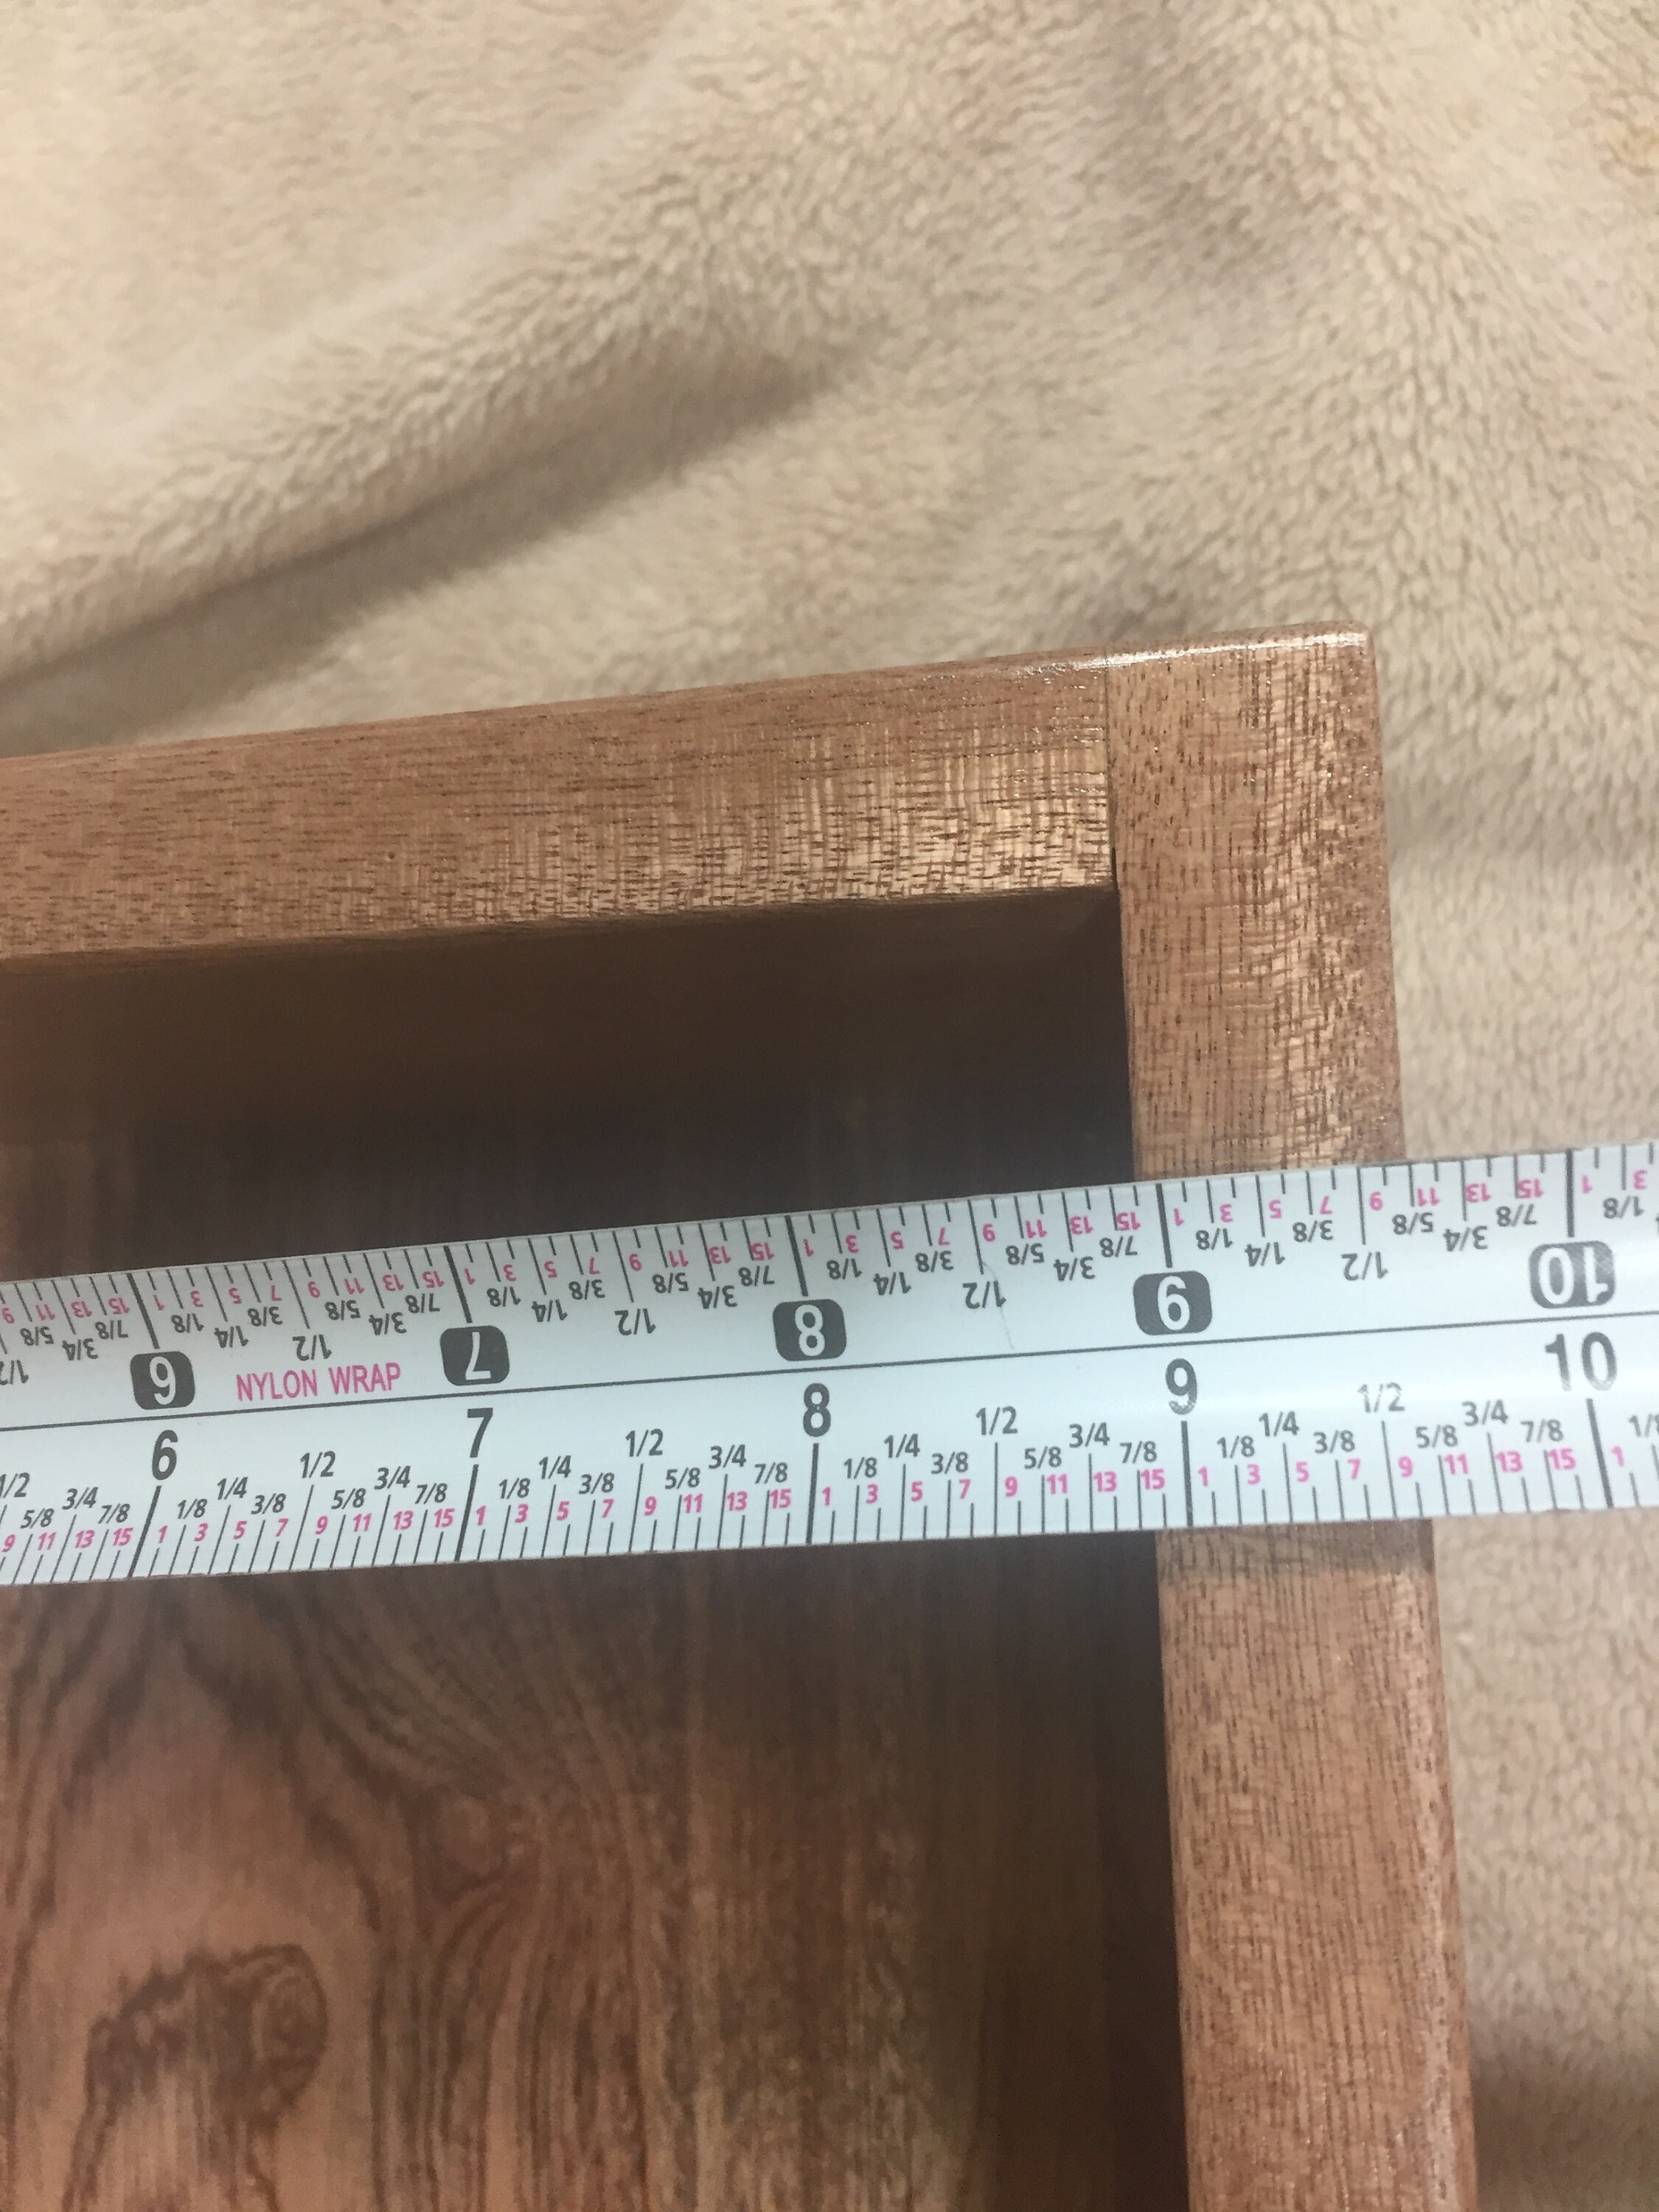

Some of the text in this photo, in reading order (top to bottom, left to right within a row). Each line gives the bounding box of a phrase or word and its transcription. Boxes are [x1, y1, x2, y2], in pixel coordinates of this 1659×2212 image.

[1517, 1180, 1543, 1198] 15
[1582, 1177, 1592, 1193] 1
[1634, 1170, 1644, 1189] 3
[1418, 1188, 1439, 1206] 11
[1466, 1183, 1490, 1202] 13
[1220, 1203, 1231, 1222] 3
[1269, 1200, 1282, 1218] 5
[1321, 1196, 1332, 1214] 7
[1496, 1203, 1537, 1227] 7/8
[1603, 1196, 1644, 1218] 1/8
[1071, 1216, 1093, 1234] 13
[1116, 1212, 1140, 1230] 15
[1175, 1208, 1183, 1225] 1
[1392, 1212, 1433, 1235] 5/8
[939, 1227, 949, 1245] 7
[1026, 1220, 1046, 1238] 11
[1196, 1228, 1233, 1250] 1/8
[1292, 1220, 1333, 1242] 3/8
[1444, 1225, 1489, 1252] 3/4
[804, 1239, 813, 1256] 1
[846, 1234, 858, 1253] 3
[891, 1231, 904, 1249] 5
[1099, 1236, 1138, 1258] 7/8
[669, 1251, 688, 1267] 11
[708, 1247, 730, 1264] 13
[751, 1242, 774, 1260] 15
[1006, 1243, 1045, 1265] 5/8
[1245, 1242, 1285, 1267] 1/4
[504, 1264, 515, 1281] 3
[544, 1260, 557, 1278] 5
[590, 1259, 598, 1274] 7
[827, 1259, 862, 1279] 1/8
[915, 1251, 953, 1273] 3/8
[1054, 1256, 1095, 1281] 3/4
[1340, 1251, 1388, 1281] 1/2
[383, 1274, 403, 1291] 13
[422, 1271, 443, 1287] 15
[465, 1269, 475, 1284] 1
[652, 1273, 689, 1293] 5/8
[738, 1265, 775, 1286] 7/8
[873, 1271, 911, 1295] 1/4
[1538, 1247, 1609, 1304] 10
[229, 1287, 241, 1304] 5
[271, 1286, 280, 1301] 7
[345, 1279, 364, 1294] 11
[487, 1286, 521, 1307] 1/8
[568, 1279, 605, 1301] 3/8
[698, 1285, 737, 1309] 3/4
[962, 1280, 1006, 1309] 1/2
[71, 1300, 91, 1318] 13
[108, 1298, 129, 1314] 15
[154, 1295, 164, 1310] 1
[191, 1290, 201, 1307] 3
[406, 1293, 440, 1314] 7/8
[36, 1304, 55, 1321] 11
[248, 1307, 283, 1326] 3/8
[324, 1300, 361, 1321] 5/8
[531, 1299, 568, 1322] 1/4
[95, 1320, 128, 1340] 7/8
[171, 1313, 204, 1333] 1/8
[369, 1312, 407, 1335] 3/4
[614, 1308, 656, 1335] 1/2
[795, 1304, 825, 1357] 8
[20, 1326, 55, 1346] 5/8
[214, 1326, 249, 1348] 1/4
[62, 1338, 98, 1360] 3/4
[292, 1335, 332, 1361] 1/2
[465, 1332, 491, 1380] 7
[1545, 1332, 1617, 1391] 10
[237, 1363, 400, 1399] NYLON WRAP
[1166, 1358, 1197, 1415] 9
[1357, 1382, 1405, 1413] 1/2
[802, 1382, 831, 1437] 8
[1462, 1399, 1509, 1426] 3/4
[976, 1406, 1018, 1436] 1/2
[1259, 1411, 1299, 1436] 1/4
[1520, 1419, 1563, 1442] 7/8
[1629, 1413, 1659, 1437] 1/
[467, 1408, 493, 1458] 7
[625, 1428, 664, 1457] 1/2
[1069, 1422, 1110, 1447] 3/4
[1313, 1430, 1355, 1454] 3/8
[1416, 1425, 1458, 1448] 5/8
[152, 1429, 178, 1481] 6
[883, 1433, 920, 1458] 1/4
[1119, 1441, 1157, 1464] 7/8
[1217, 1436, 1254, 1458] 1/8
[1612, 1446, 1625, 1466] 1
[299, 1451, 335, 1478] 1/2
[538, 1455, 571, 1479] 1/4
[709, 1444, 746, 1469] 3/4
[931, 1451, 969, 1474] 3/8
[1024, 1446, 1062, 1469] 5/8
[1399, 1456, 1413, 1477] 9
[1445, 1453, 1468, 1474] 11
[1496, 1451, 1522, 1472] 13
[1549, 1448, 1576, 1469] 15
[375, 1466, 411, 1489] 3/4
[665, 1467, 700, 1489] 5/8
[755, 1462, 787, 1484] 7/8
[844, 1458, 877, 1479] 1/8
[1199, 1467, 1208, 1485] 1
[1248, 1464, 1260, 1484] 3
[1296, 1461, 1310, 1482] 5
[1348, 1458, 1360, 1478] 7
[217, 1477, 248, 1500] 1/4
[499, 1478, 530, 1499] 1/8
[578, 1472, 615, 1494] 3/8
[959, 1478, 970, 1498] 7
[1005, 1476, 1018, 1497] 9
[1047, 1474, 1068, 1493] 11
[1094, 1471, 1116, 1492] 13
[1141, 1469, 1165, 1489] 15
[62, 1487, 98, 1509] 3/4
[332, 1488, 366, 1509] 5/8
[414, 1483, 448, 1504] 7/8
[727, 1491, 748, 1510] 13
[769, 1489, 790, 1508] 15
[823, 1486, 831, 1505] 1
[867, 1484, 877, 1503] 3
[911, 1481, 922, 1501] 5
[98, 1503, 130, 1523] 7/8
[178, 1498, 207, 1519] 1/8
[251, 1493, 286, 1514] 3/8
[515, 1503, 528, 1523] 3
[557, 1500, 569, 1520] 5
[603, 1498, 613, 1517] 7
[645, 1496, 657, 1516] 9
[684, 1494, 703, 1512] 11
[20, 1508, 55, 1528] 5/8
[316, 1516, 328, 1534] 9
[354, 1514, 371, 1531] 11
[394, 1510, 413, 1529] 13
[435, 1508, 454, 1527] 15
[476, 1506, 486, 1524] 1
[114, 1528, 133, 1545] 15
[160, 1526, 167, 1542] 1
[195, 1523, 208, 1541] 3
[234, 1520, 246, 1539] 5
[276, 1517, 289, 1536] 7
[4, 1534, 15, 1551] 9
[38, 1533, 55, 1549] 11
[76, 1529, 94, 1548] 13
